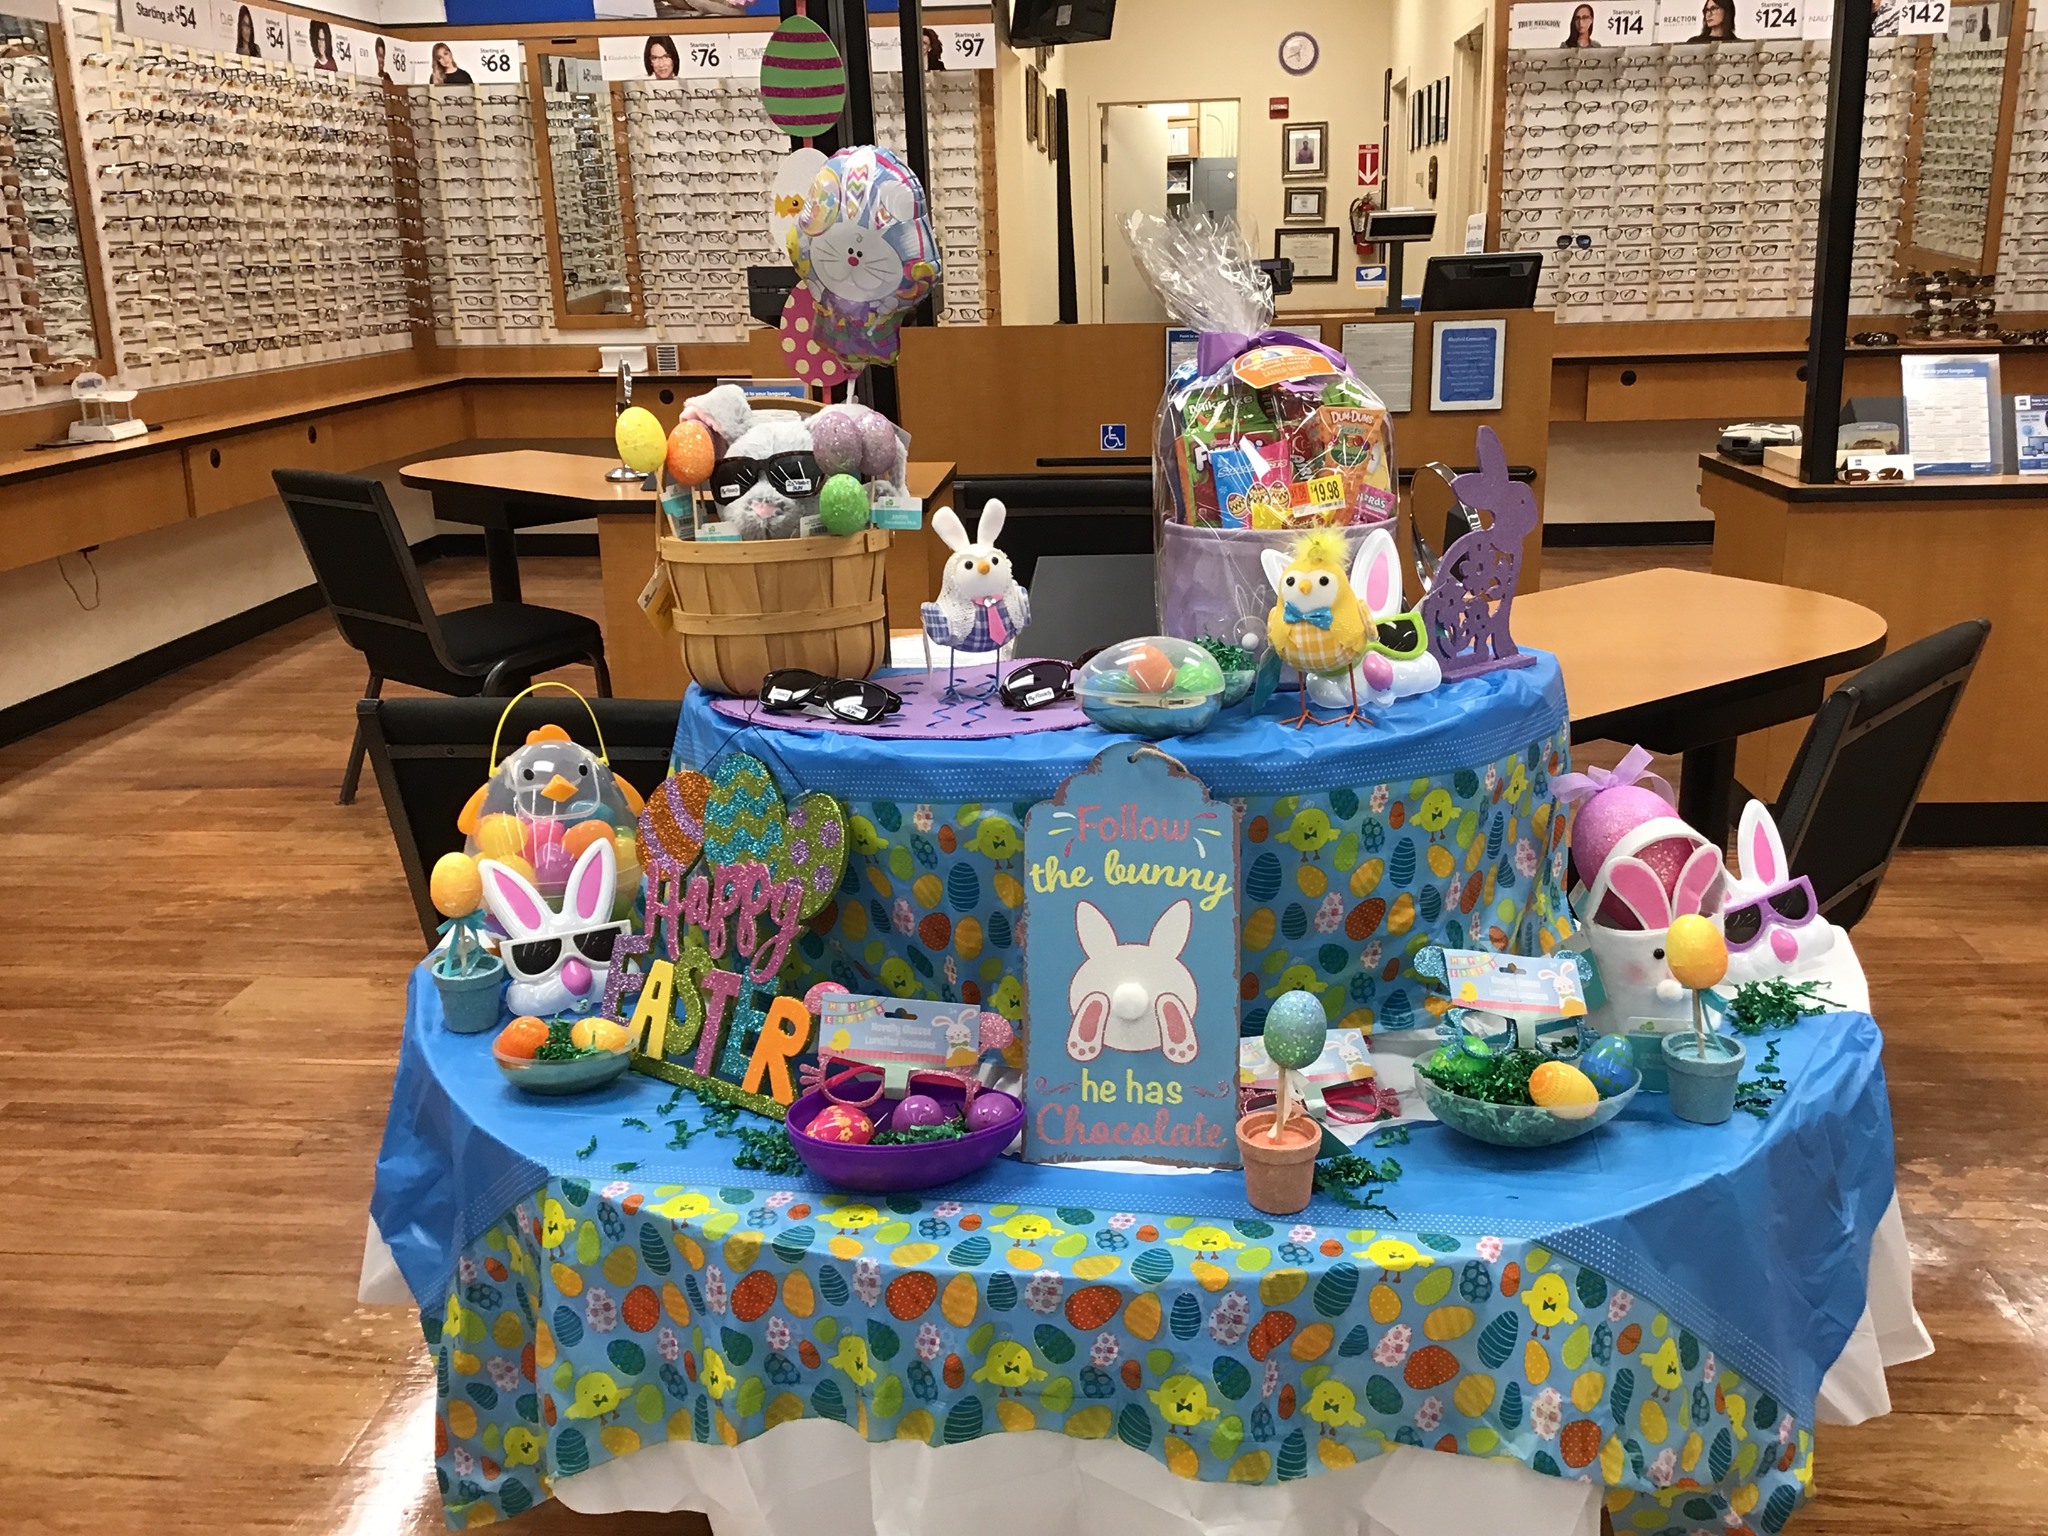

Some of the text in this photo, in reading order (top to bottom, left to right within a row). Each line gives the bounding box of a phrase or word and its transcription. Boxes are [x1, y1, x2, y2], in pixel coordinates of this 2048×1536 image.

[135, 2, 197, 29] Starting at $54
[1608, 15, 1643, 35] $114
[1664, 15, 1697, 23] REACTION
[1755, 8, 1797, 28] $124
[1901, 4, 1945, 25] $142
[266, 26, 284, 48] $54
[955, 38, 985, 57] $97
[336, 41, 352, 62] $54
[691, 48, 720, 67] $76
[392, 53, 406, 72] $68
[481, 54, 511, 72] $68
[1310, 480, 1340, 503] $19.98
[1076, 803, 1191, 842] Follow
[1029, 849, 1232, 911] the bunny
[645, 858, 804, 983] Happy
[601, 934, 812, 1105] EASTER
[1081, 1068, 1183, 1104] he has
[1036, 1102, 1229, 1149] Chocolate
